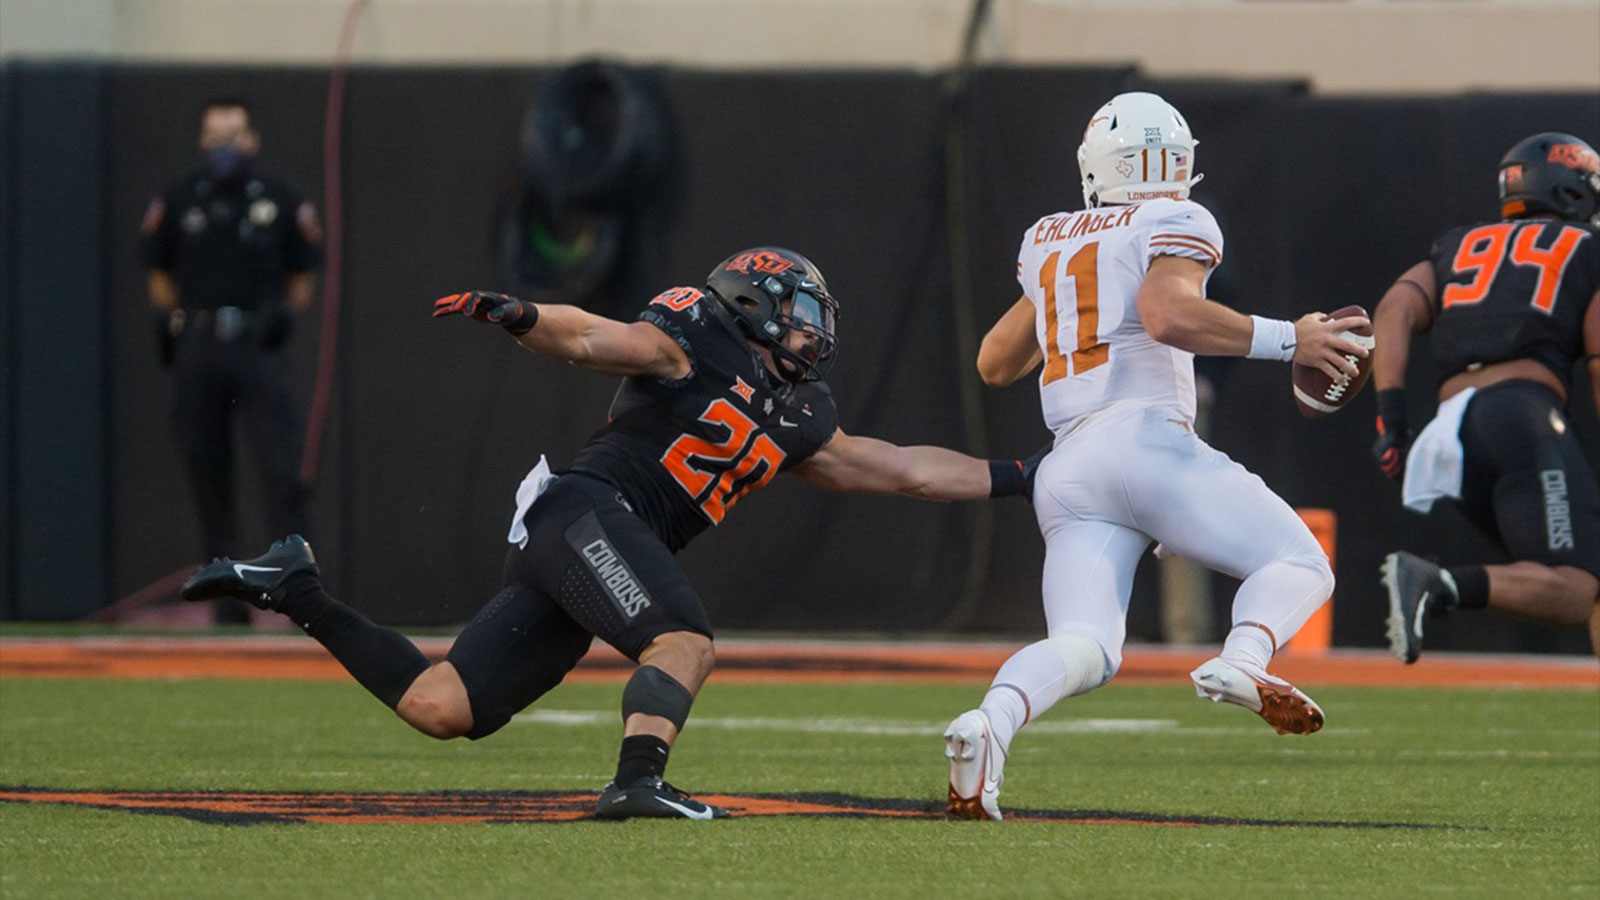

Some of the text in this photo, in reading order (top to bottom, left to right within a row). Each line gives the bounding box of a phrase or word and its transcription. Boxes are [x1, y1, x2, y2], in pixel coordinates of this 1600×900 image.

[1141, 147, 1167, 182] 11
[1034, 205, 1141, 245] EHLINGER
[1443, 223, 1592, 317] 94
[1039, 241, 1111, 387] 11
[659, 397, 788, 527] 20
[1541, 469, 1574, 550] COWBOYS
[582, 538, 652, 618] COWBOYS
